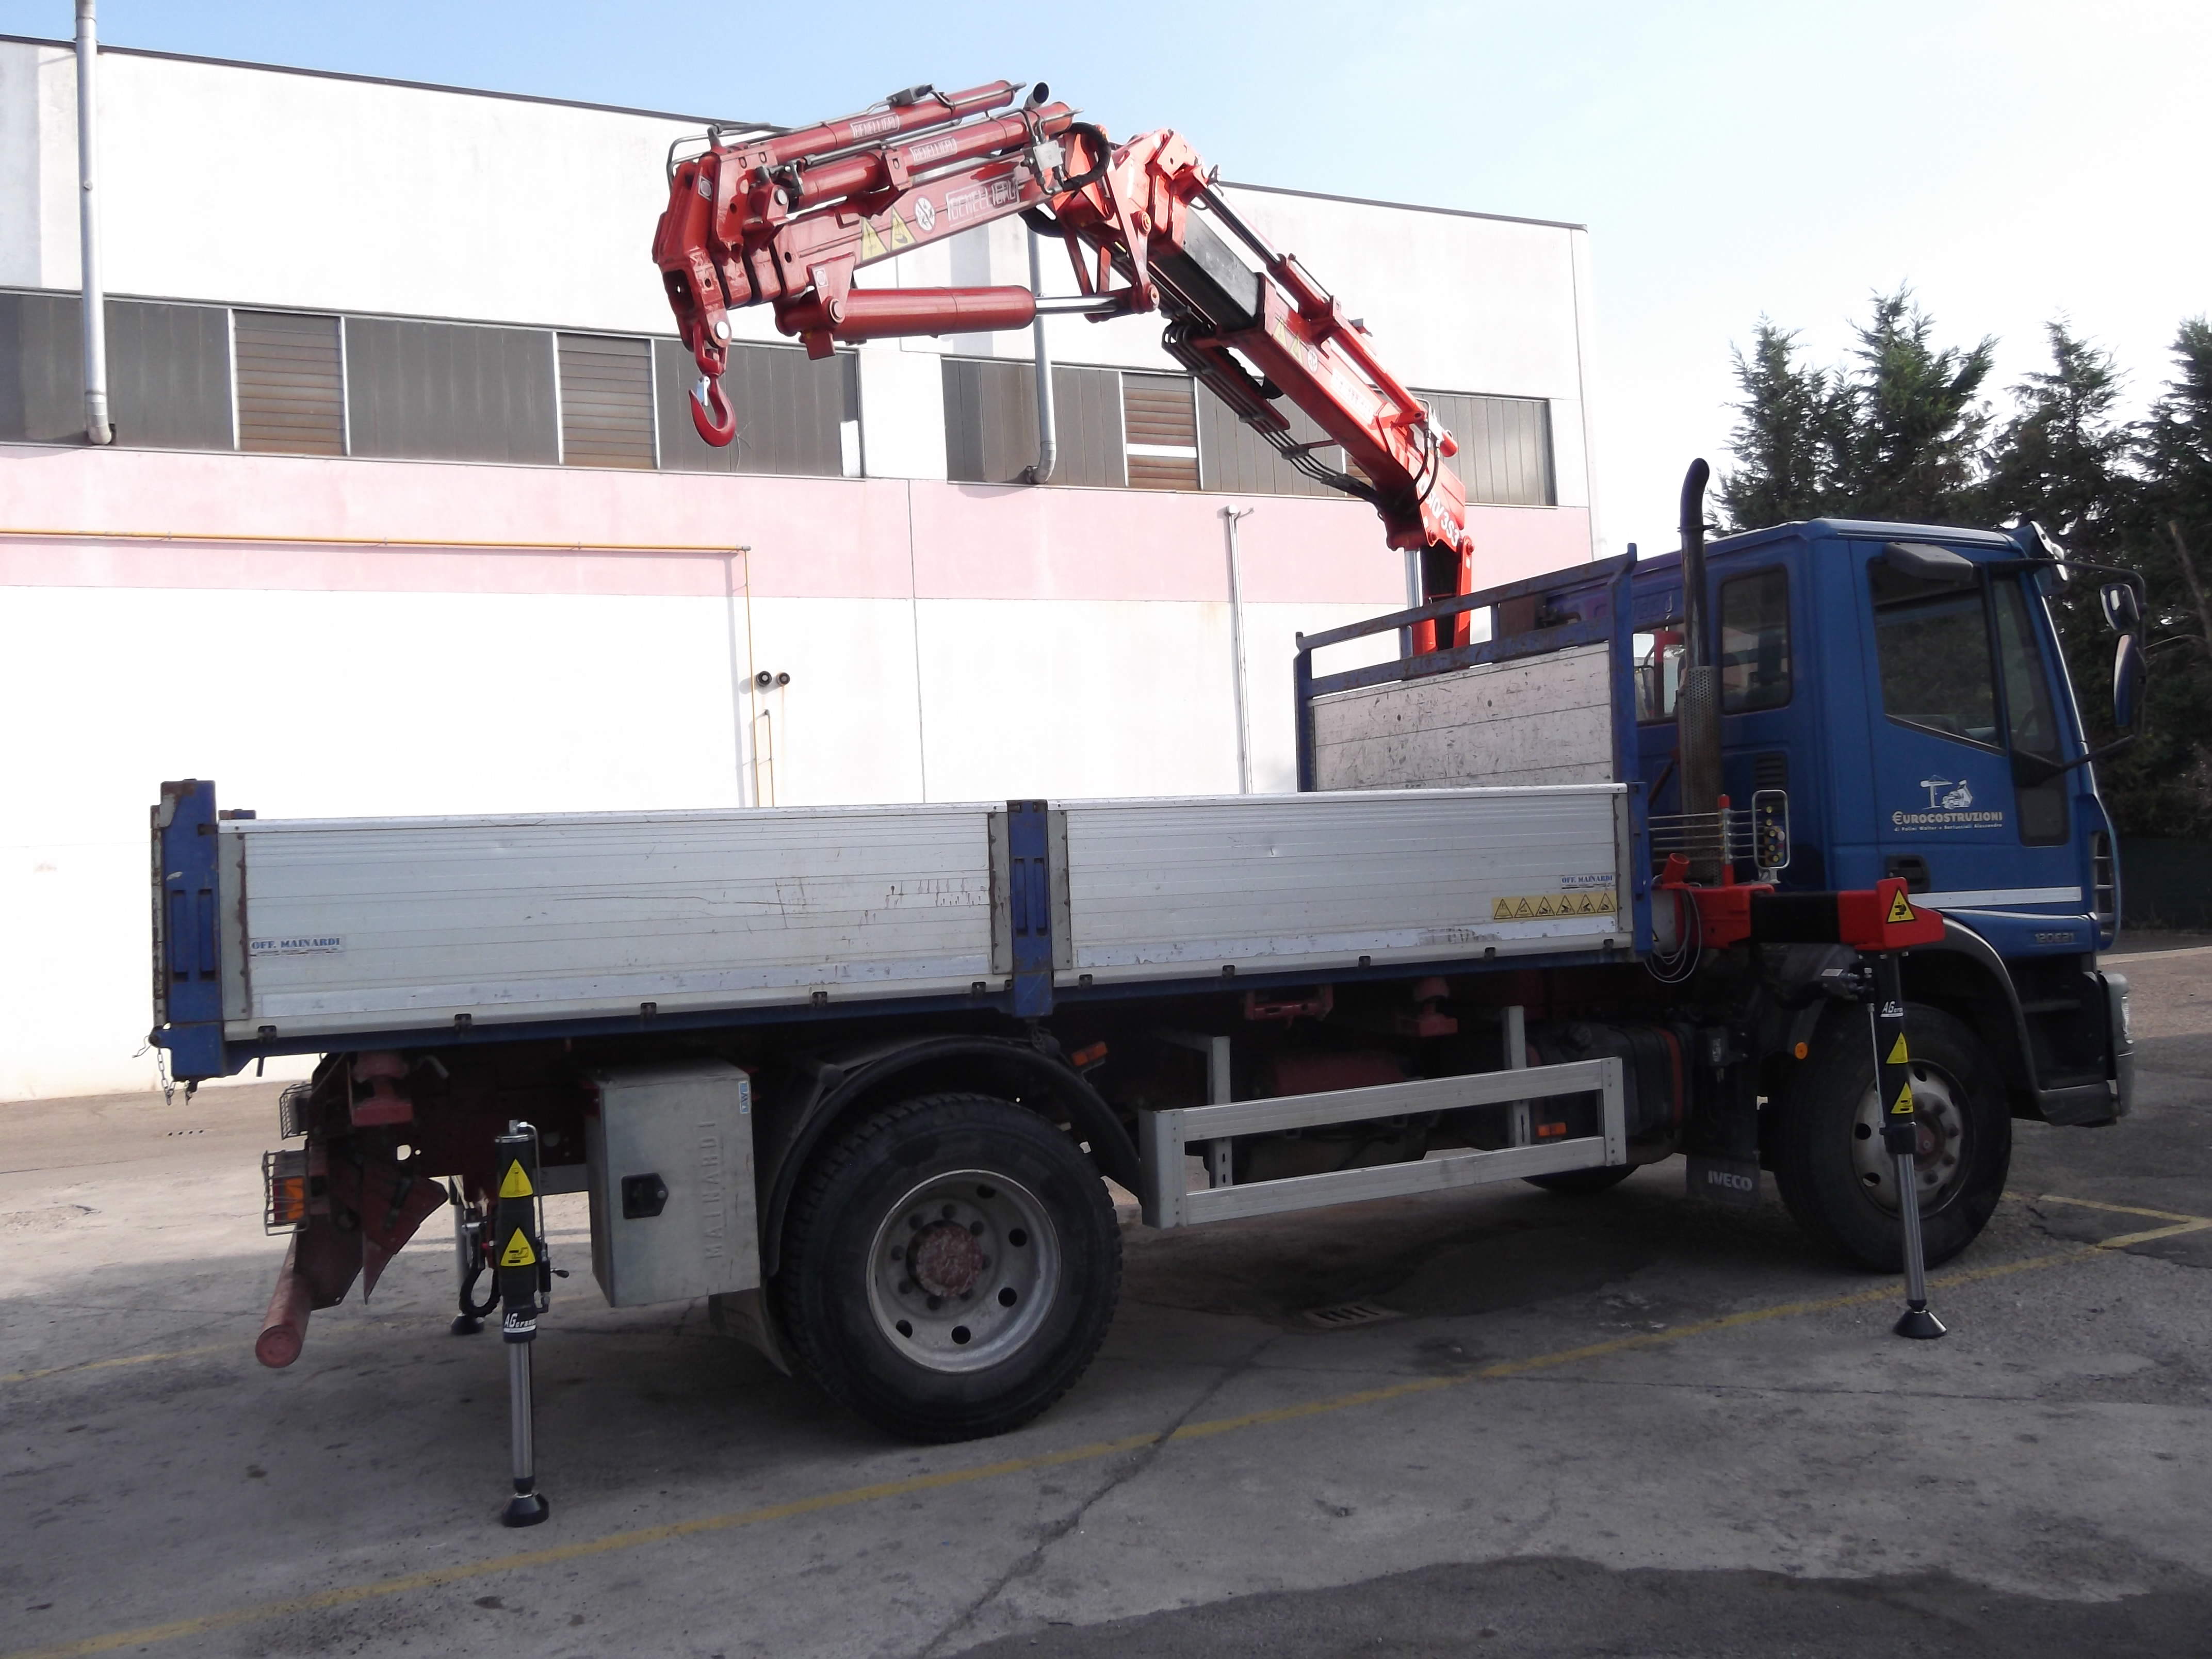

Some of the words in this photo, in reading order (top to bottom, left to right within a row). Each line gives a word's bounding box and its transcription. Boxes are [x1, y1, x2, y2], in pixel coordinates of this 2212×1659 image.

[251, 940, 276, 950] OFF.
[280, 937, 340, 948] MAINARDI
[698, 1123, 723, 1259] MAINARDI
[1708, 1169, 1752, 1191] IVECO
